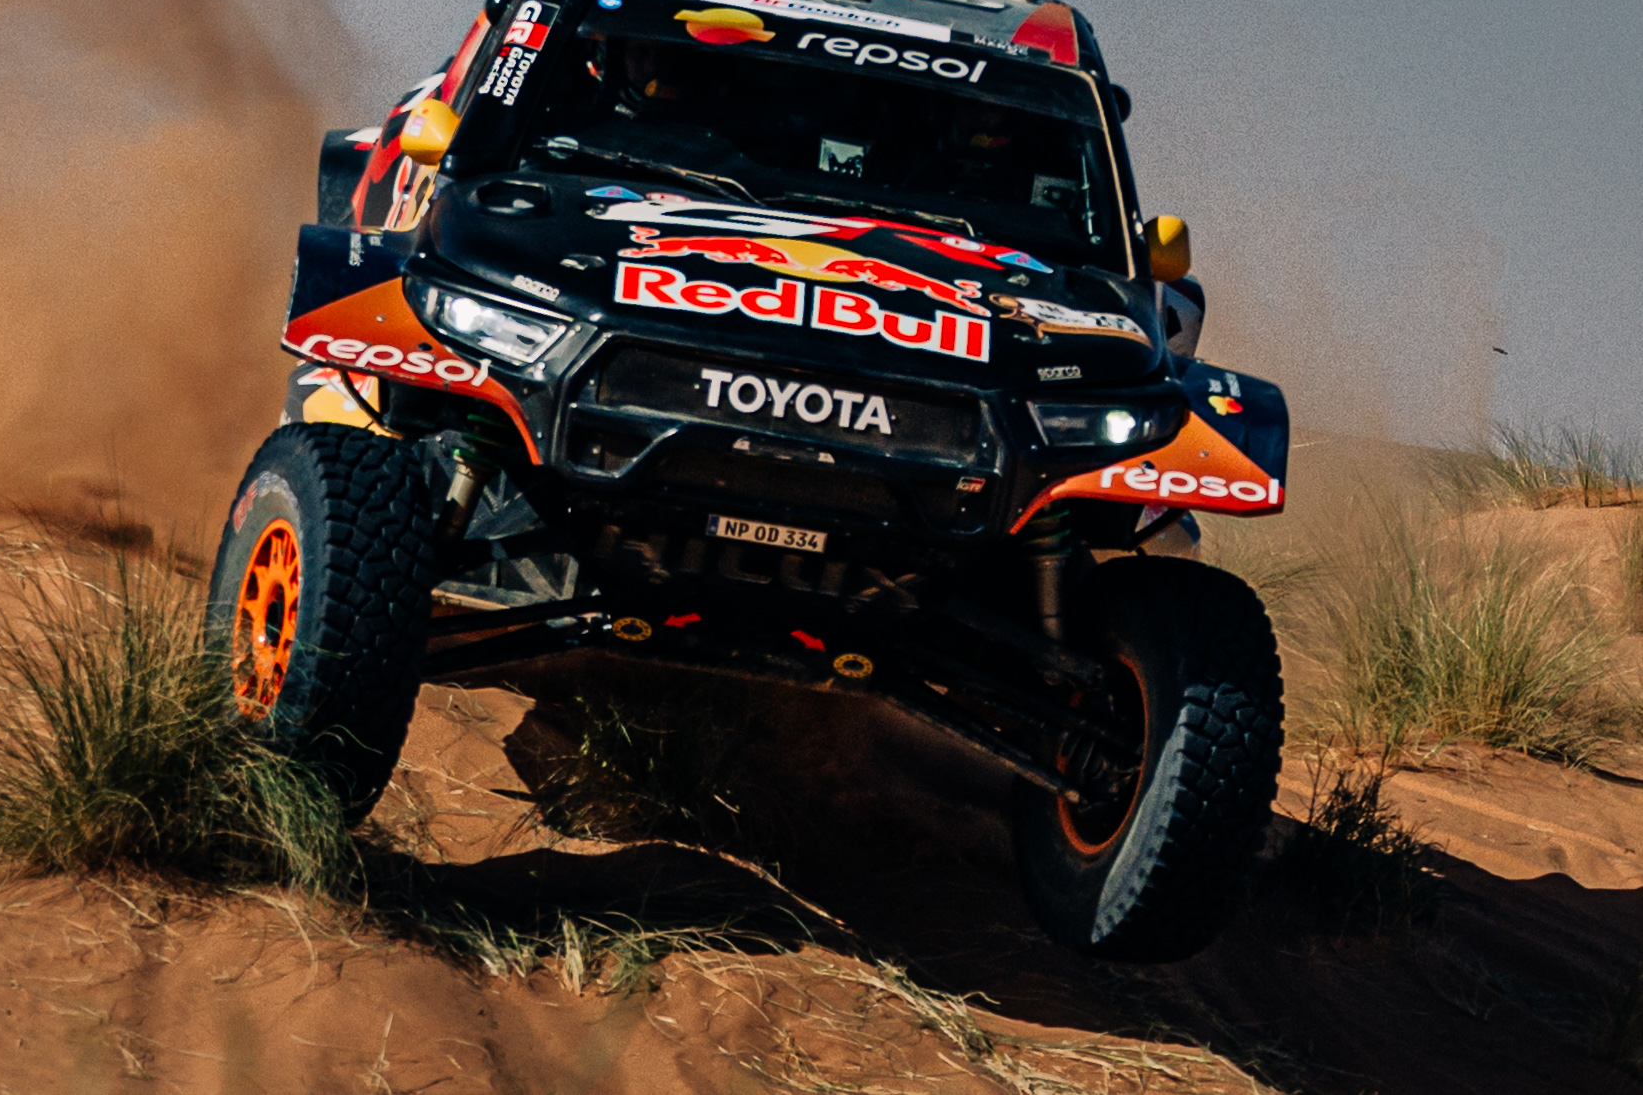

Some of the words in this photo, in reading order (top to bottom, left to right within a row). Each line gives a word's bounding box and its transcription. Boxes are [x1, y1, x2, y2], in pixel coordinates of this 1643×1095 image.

[504, 0, 543, 44] GR
[492, 46, 523, 97] GAZOO
[502, 51, 537, 106] TOYOTA
[796, 32, 987, 84] repsol
[615, 261, 805, 326] Red
[811, 285, 990, 363] Bull
[301, 333, 491, 388] repsol
[700, 368, 893, 435] TOYOTA
[1100, 464, 1279, 504] repsol
[724, 521, 749, 540] NP
[755, 526, 779, 544] OD
[784, 531, 819, 550] 334
